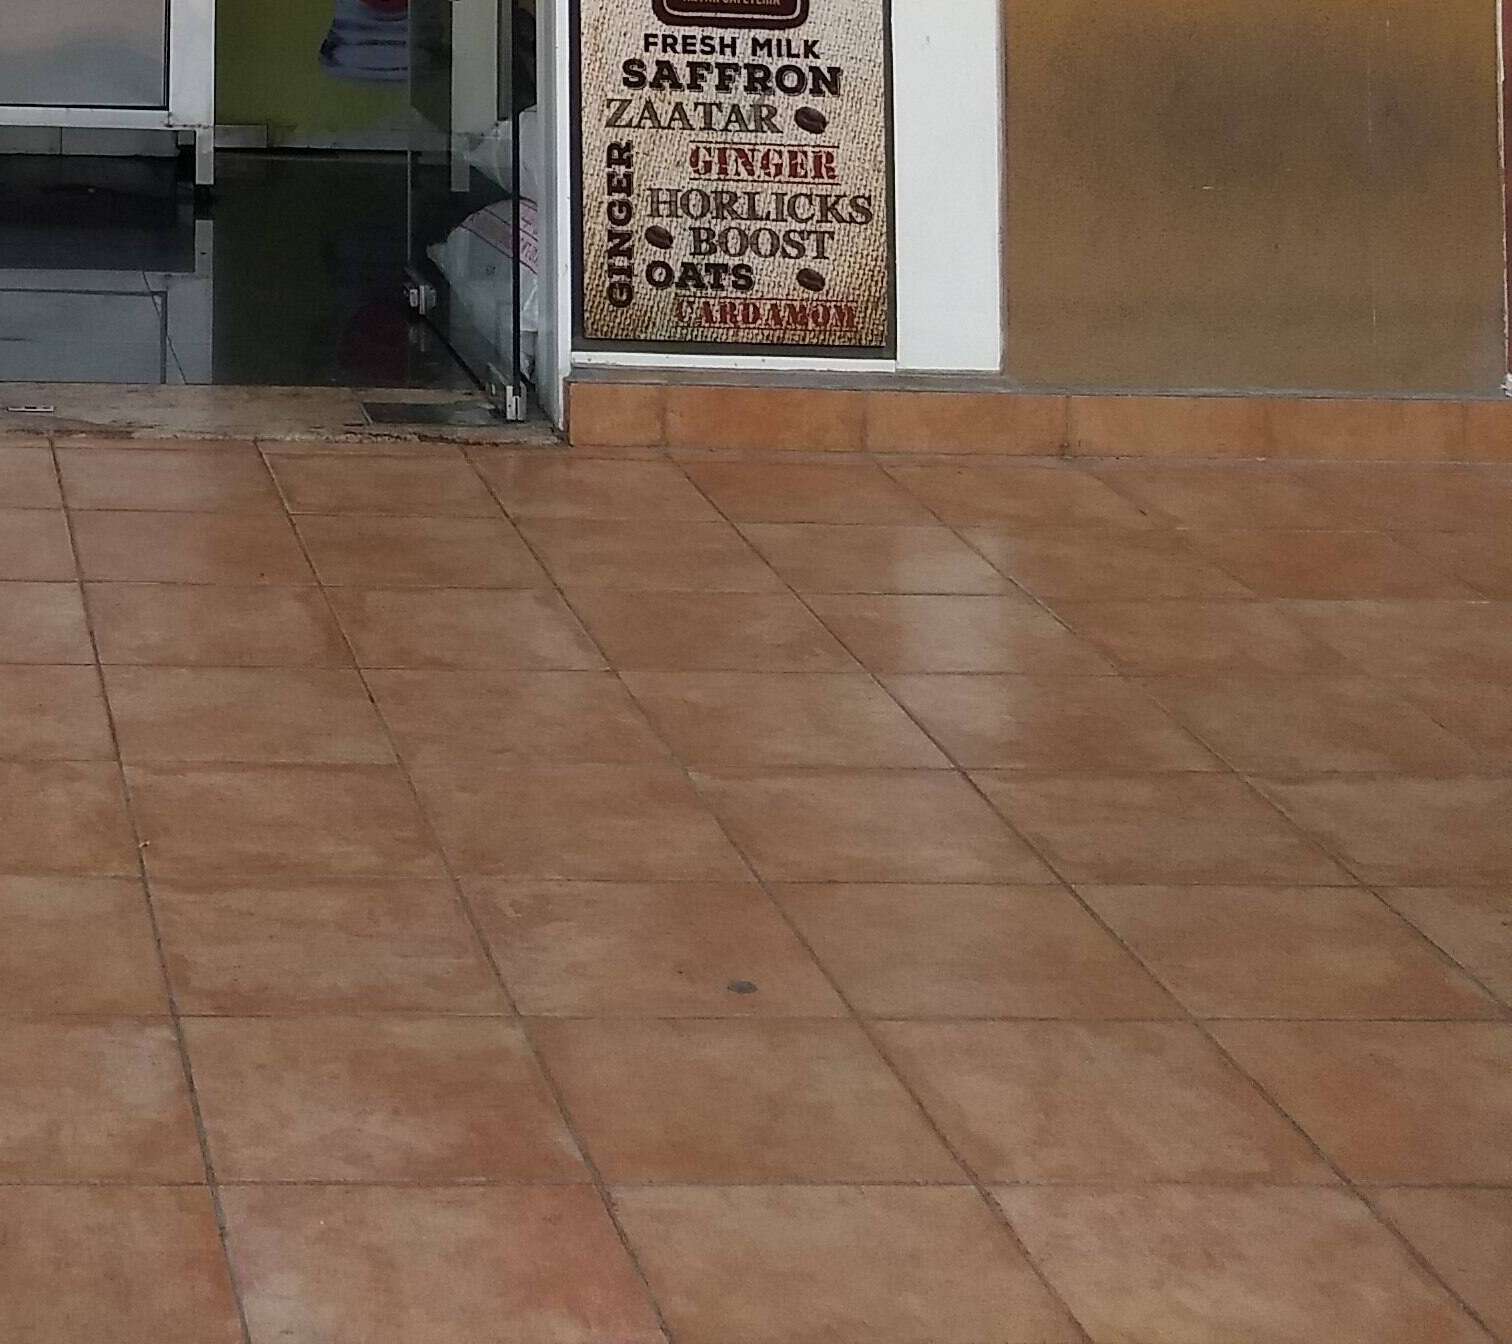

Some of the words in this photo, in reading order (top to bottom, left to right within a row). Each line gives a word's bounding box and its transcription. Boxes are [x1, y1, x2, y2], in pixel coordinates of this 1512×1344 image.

[644, 33, 737, 57] FRESH
[752, 38, 820, 59] MILK
[622, 58, 841, 96] SAFFRON
[605, 98, 783, 133] ZAATAR
[689, 146, 838, 180] GINGER
[645, 187, 873, 225] HORLICKS
[607, 141, 633, 307] GINGER
[690, 227, 835, 260] BOOST
[645, 260, 754, 291] OATS
[676, 300, 857, 328] CARDAMOM
